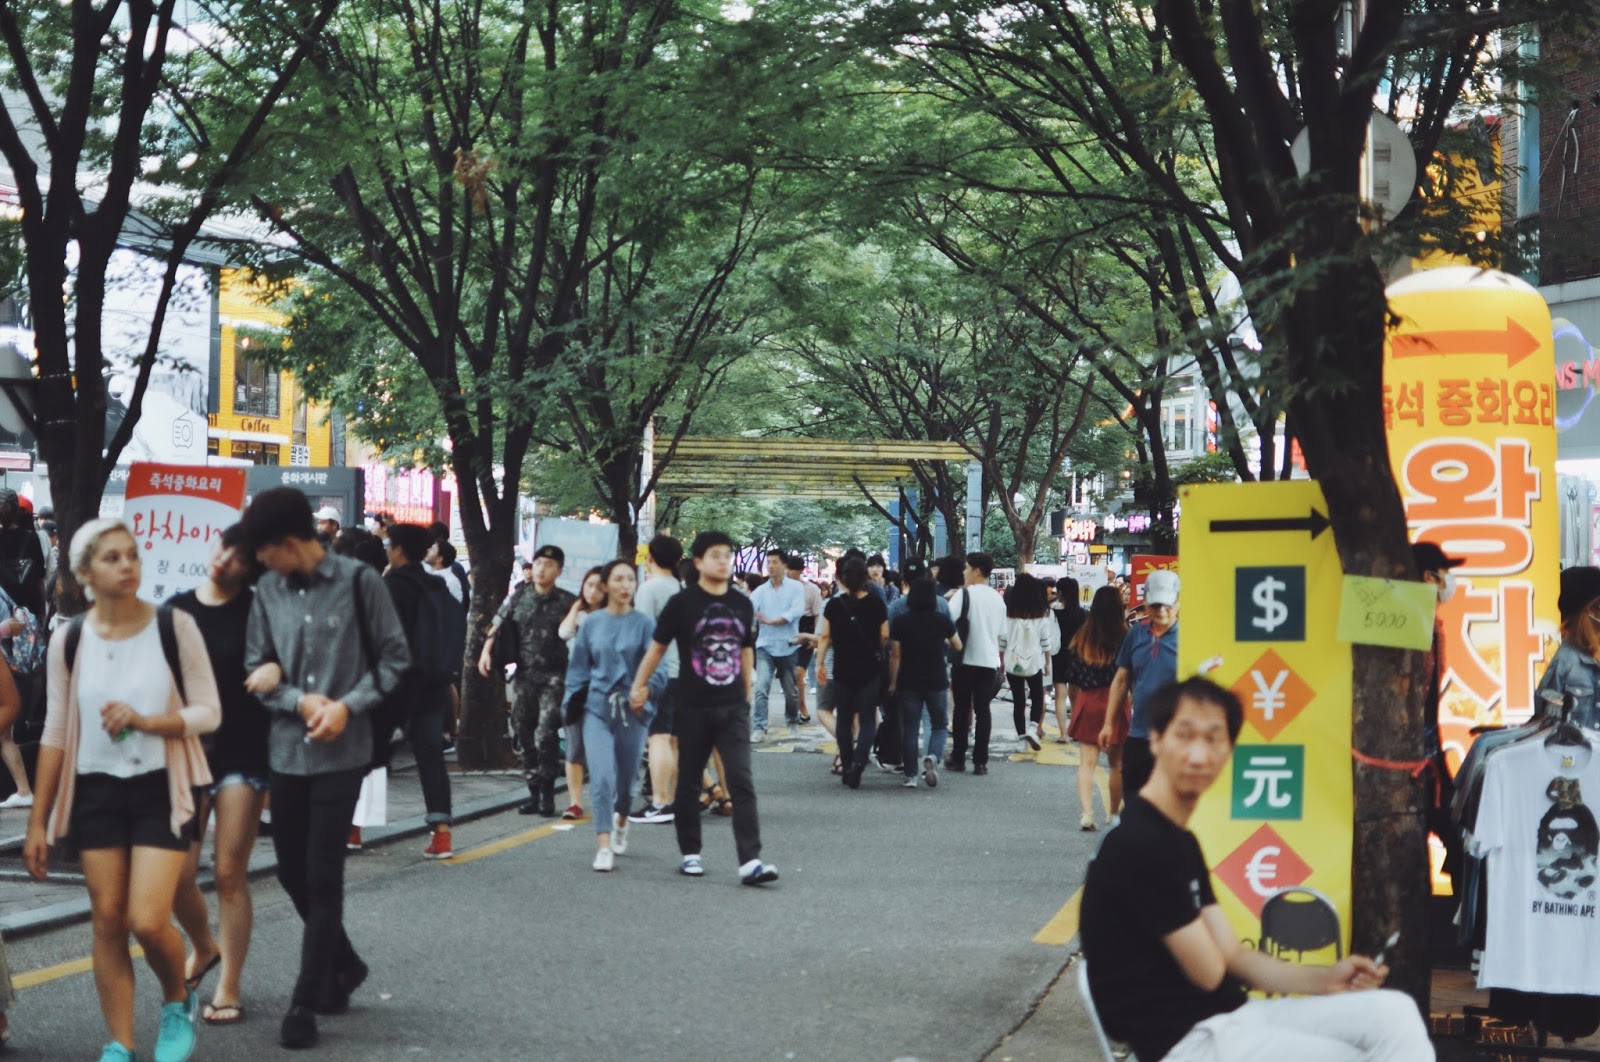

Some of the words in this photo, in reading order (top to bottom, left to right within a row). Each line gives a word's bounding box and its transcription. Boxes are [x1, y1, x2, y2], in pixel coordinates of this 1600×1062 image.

[1436, 376, 1555, 430] 중화요리
[241, 417, 270, 433] Coffee
[150, 473, 222, 493] 즉석중화요리
[281, 472, 328, 485] 문화게시판
[1363, 611, 1407, 630] 5000
[1242, 756, 1294, 808] 元
[1532, 901, 1543, 914] BY
[1544, 902, 1579, 917] BATHING
[1580, 905, 1596, 919] APE
